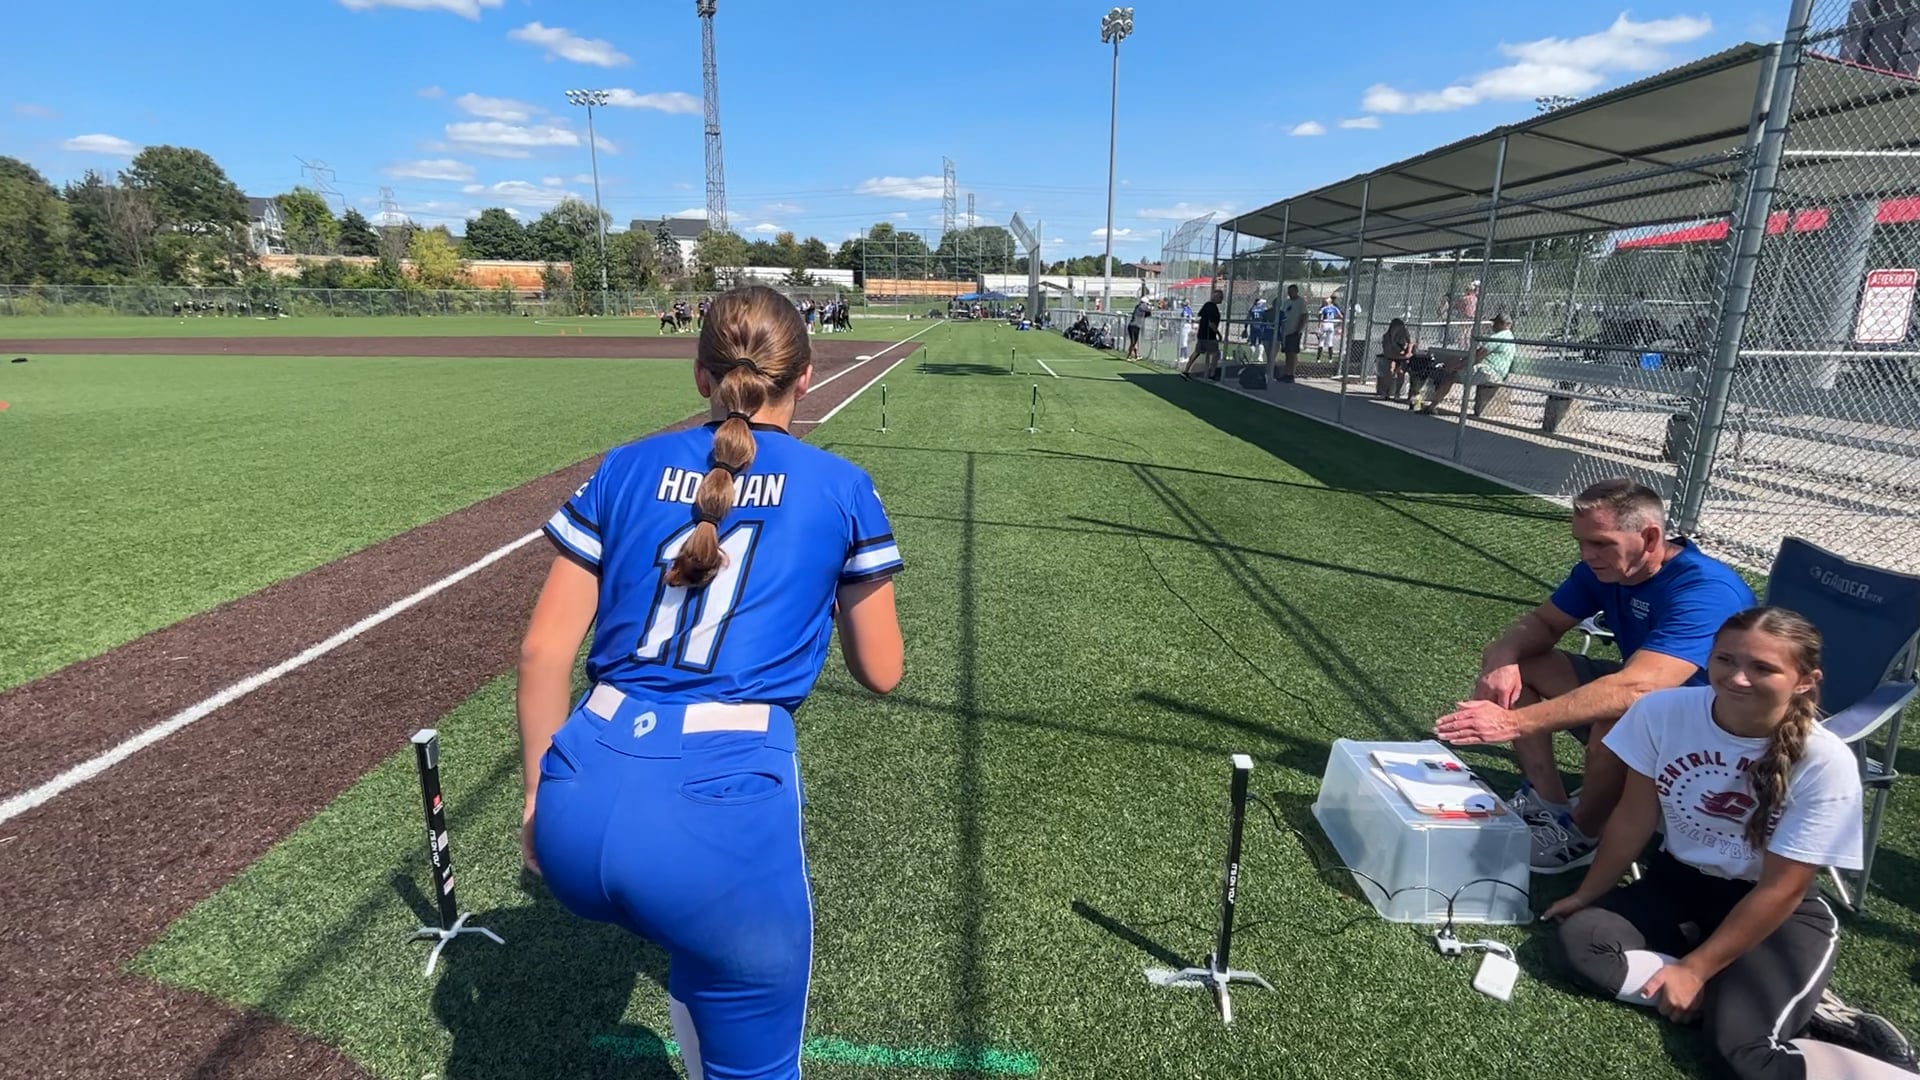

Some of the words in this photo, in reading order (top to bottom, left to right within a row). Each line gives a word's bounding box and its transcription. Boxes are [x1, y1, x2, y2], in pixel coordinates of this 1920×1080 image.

[656, 465, 787, 508] HOAN
[633, 519, 764, 674] 11
[1657, 750, 1727, 797] CENTRAL
